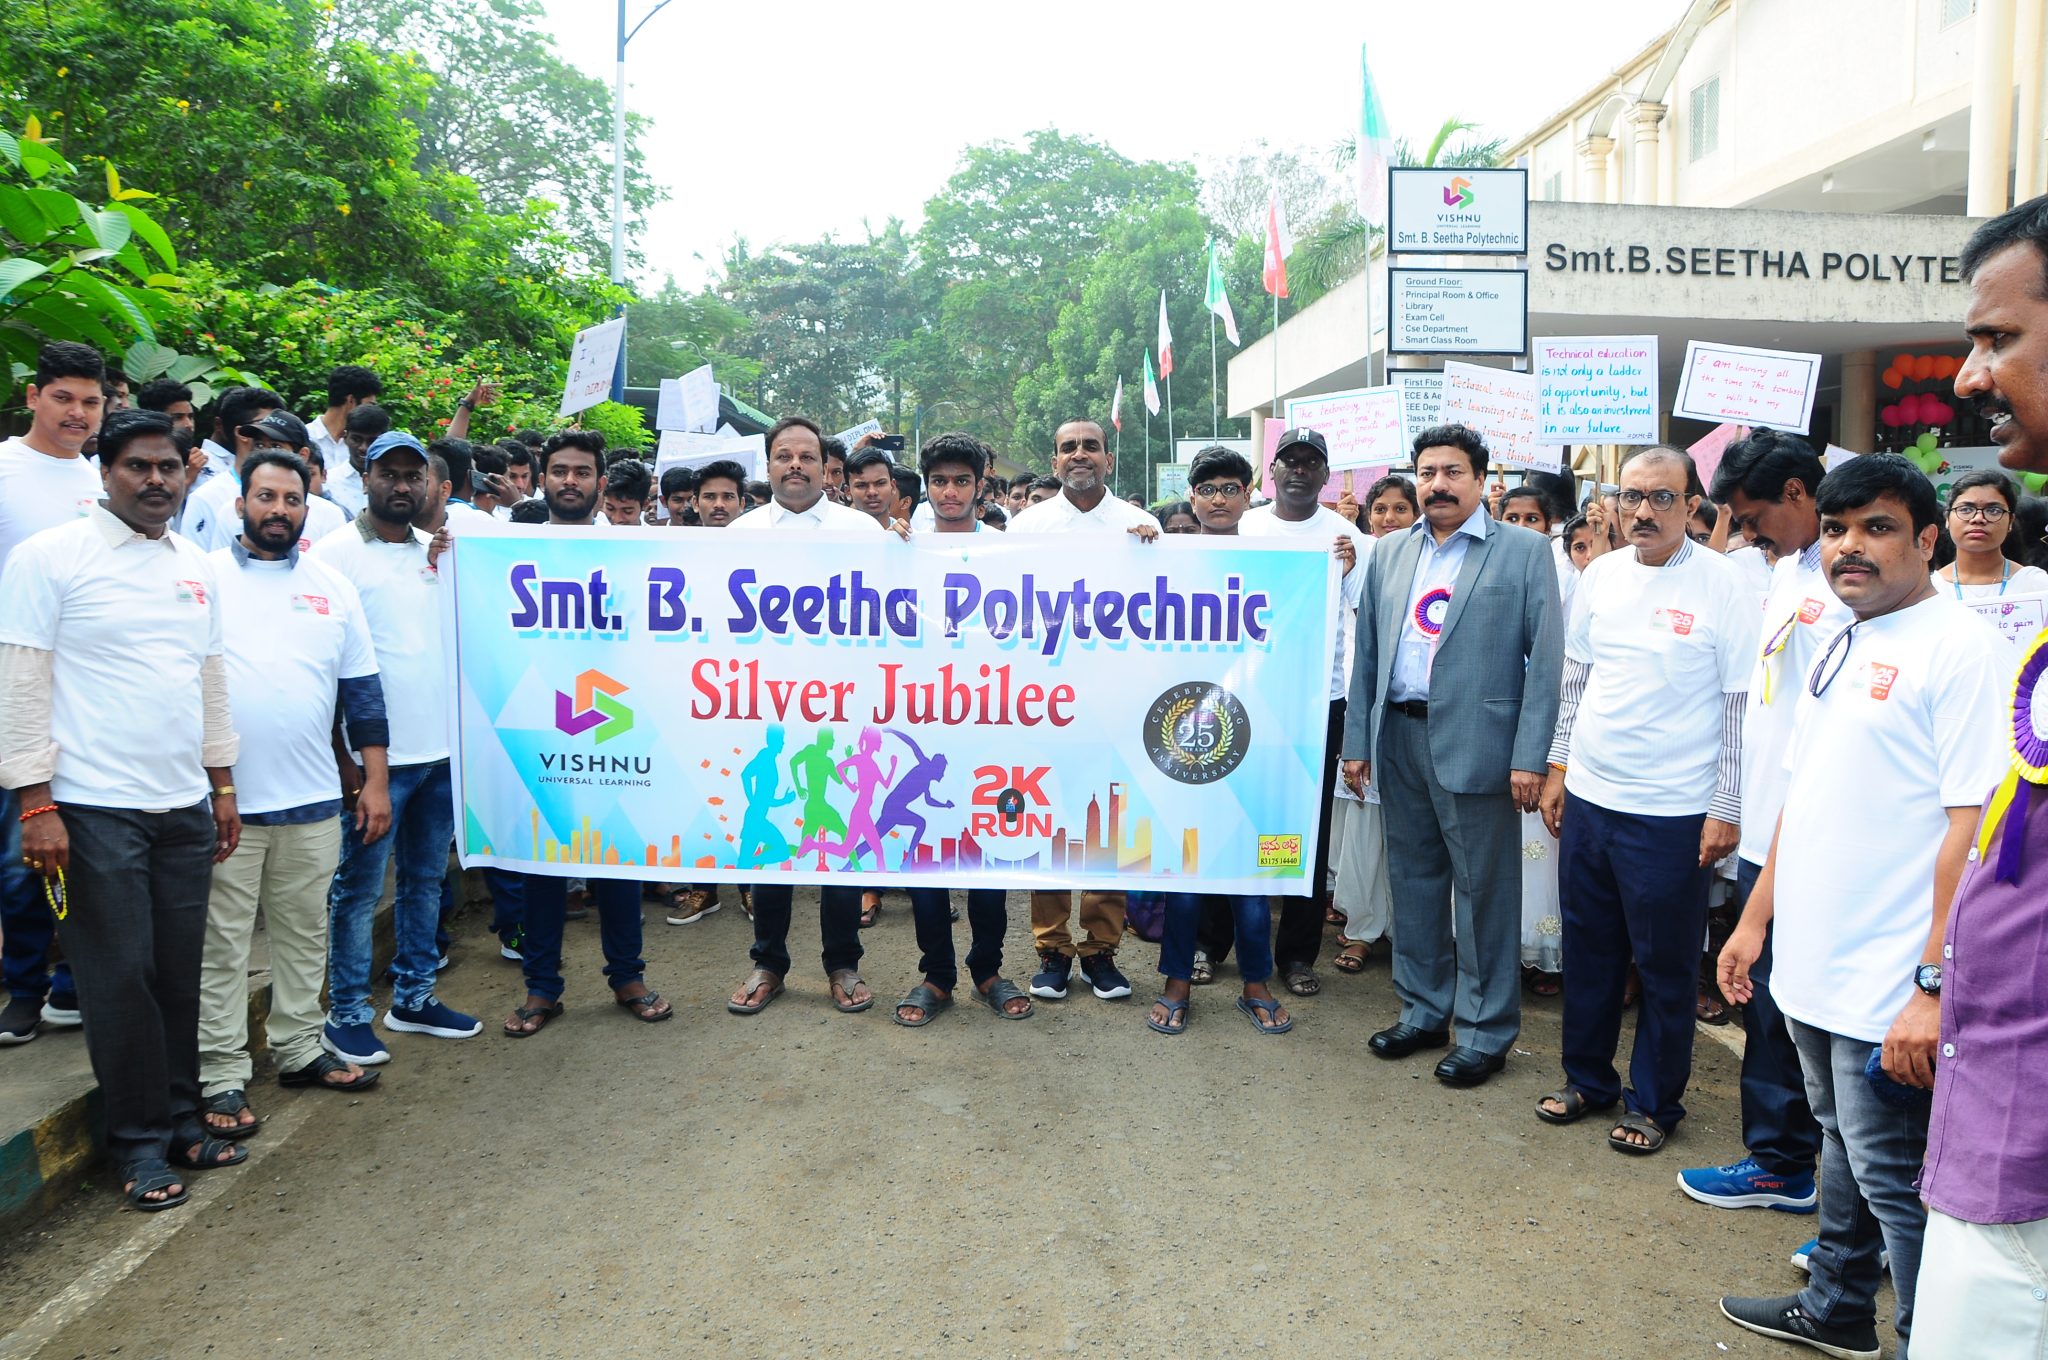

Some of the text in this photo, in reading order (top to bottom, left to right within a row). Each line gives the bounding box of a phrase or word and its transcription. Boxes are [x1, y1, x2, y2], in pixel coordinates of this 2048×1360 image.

[1437, 214, 1481, 222] VISHNU
[1398, 232, 1519, 247] Smt. B. Seetha Polytechnic
[1405, 278, 1463, 286] Ground Floor:
[1405, 291, 1441, 300] Principal
[1476, 292, 1499, 300] Office
[1405, 303, 1434, 311] Library
[1422, 325, 1469, 334] Department
[1405, 336, 1429, 344] Smart
[1430, 336, 1453, 344] Class
[1546, 347, 1647, 359] Technical education
[1541, 363, 1642, 381] is not only a ladder
[1713, 360, 1731, 368] am
[1736, 363, 1768, 378] learning
[1776, 370, 1789, 378] all
[1404, 378, 1424, 386] First
[1404, 392, 1422, 400] ECE
[1542, 384, 1552, 396] of
[1630, 386, 1648, 397] but
[1447, 398, 1464, 408] not
[1467, 398, 1505, 424] learning
[1507, 407, 1518, 419] of
[1521, 408, 1535, 422] the
[1542, 402, 1551, 416] it
[1557, 404, 1566, 416] is
[1570, 402, 1589, 415] also
[1604, 404, 1652, 416] investment
[1544, 421, 1556, 434] in
[1562, 425, 1580, 433] our
[1506, 447, 1535, 465] think
[510, 564, 1268, 656] Smt. B. Seetha Polytechnic
[691, 658, 1076, 727] Silver Jubilee
[1178, 720, 1215, 748] 25
[539, 752, 651, 775] VISHNU
[1152, 746, 1240, 780] ANNIVERSARY
[538, 776, 651, 787] UNIVERSAL LEARNING
[972, 764, 1052, 806] 2K
[972, 812, 1053, 838] RUN
